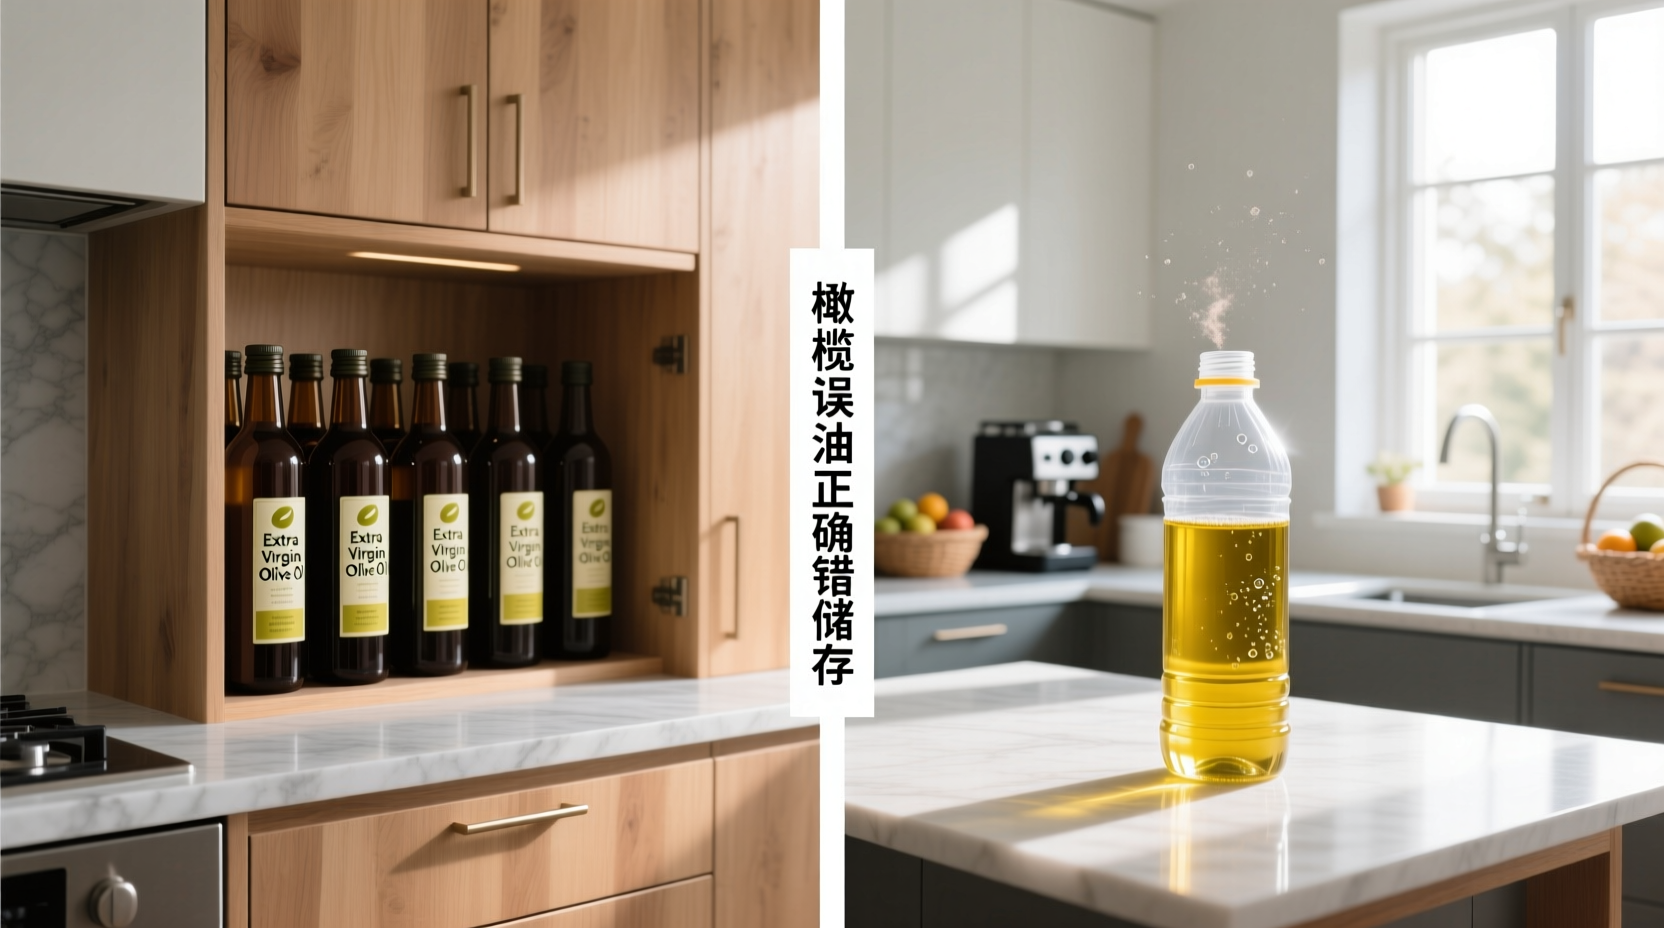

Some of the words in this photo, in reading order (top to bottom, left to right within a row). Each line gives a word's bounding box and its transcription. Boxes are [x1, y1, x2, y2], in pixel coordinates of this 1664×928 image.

[263, 533, 299, 547] Extra
[350, 530, 383, 544] Extra
[261, 549, 302, 567] Virgin
[348, 546, 386, 563] Virgin
[259, 566, 291, 581] Olive
